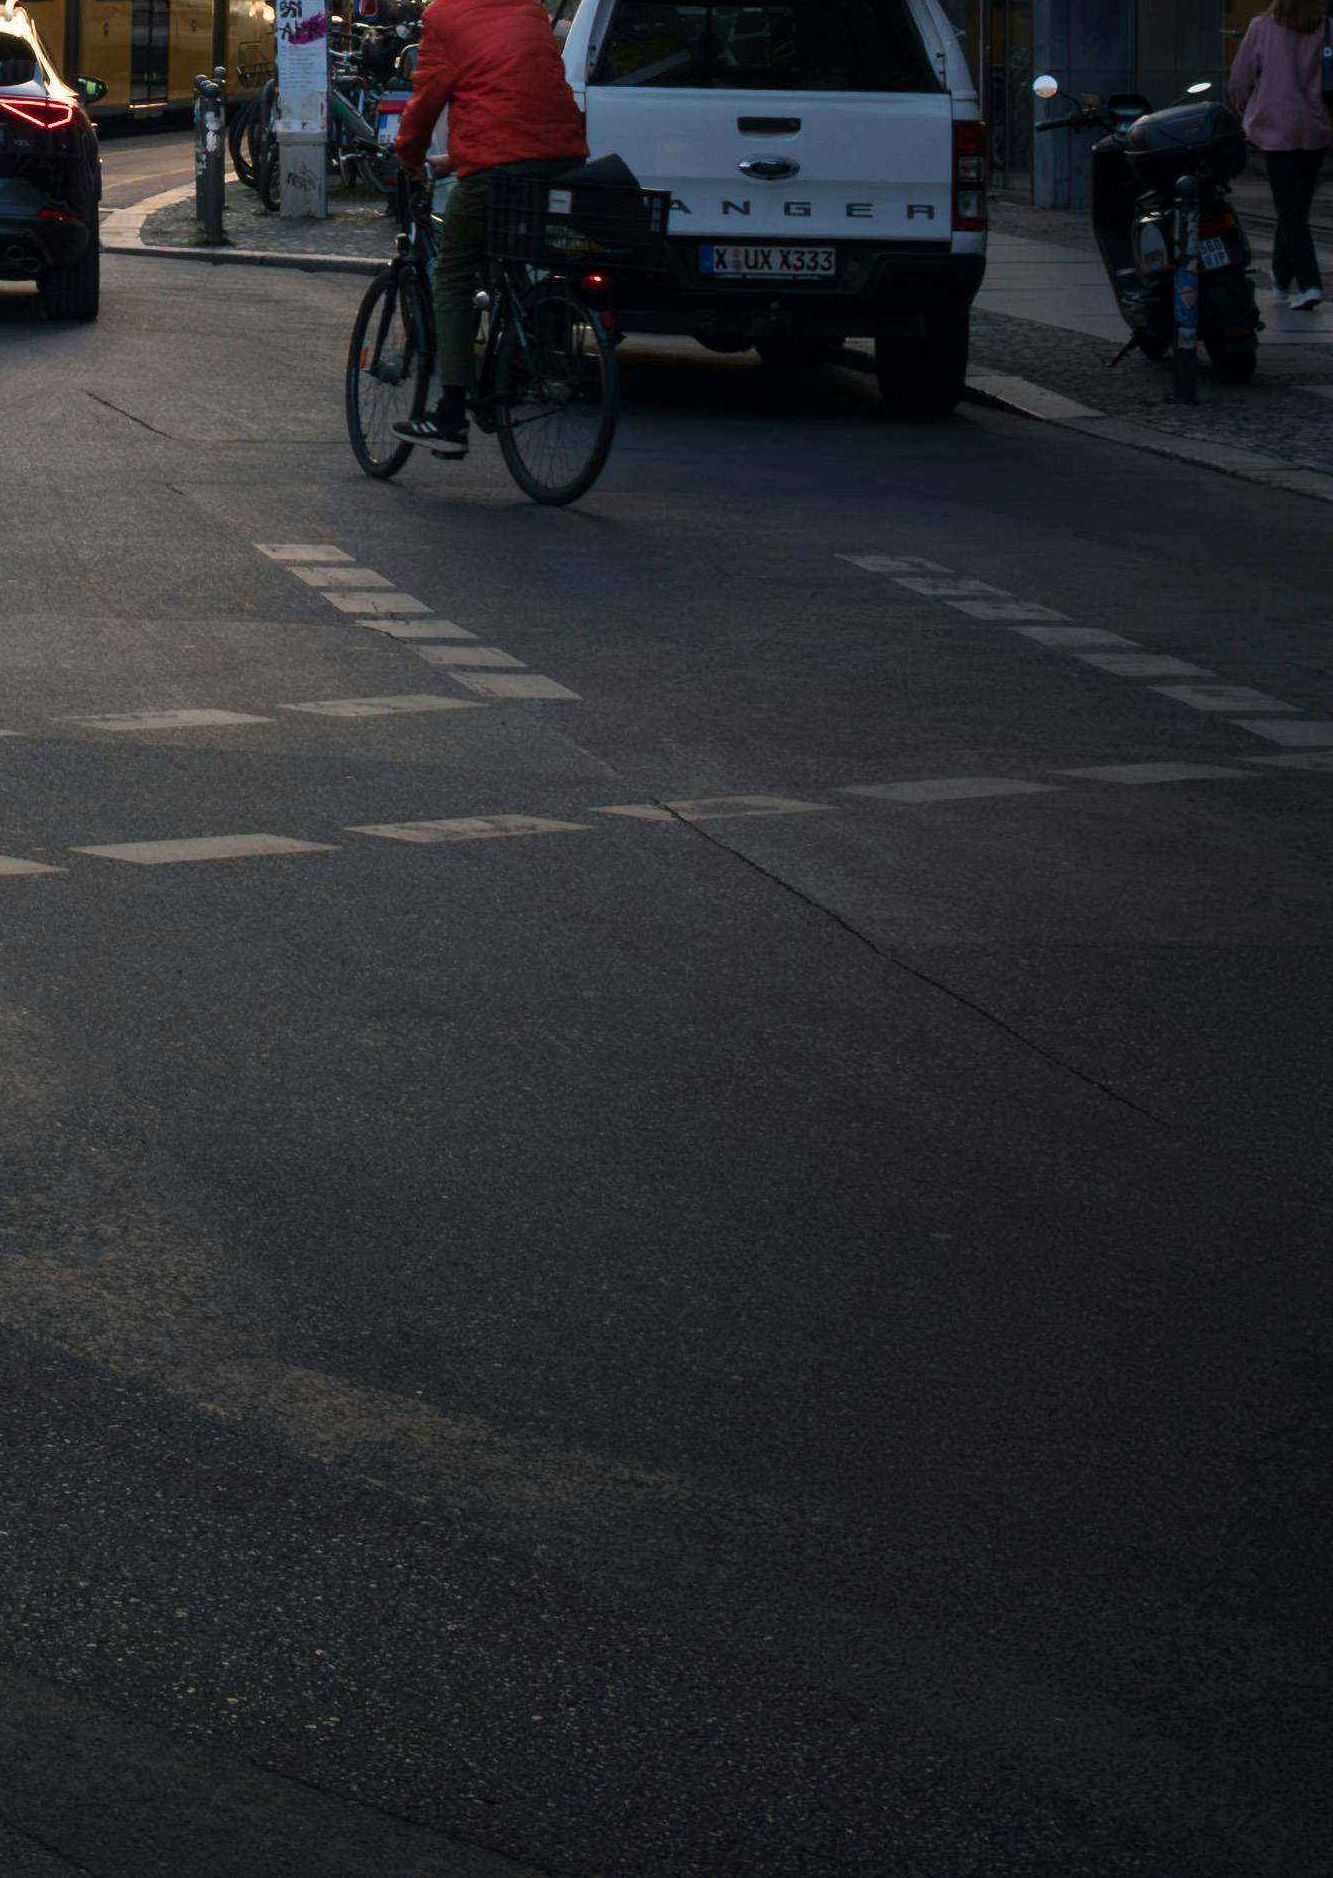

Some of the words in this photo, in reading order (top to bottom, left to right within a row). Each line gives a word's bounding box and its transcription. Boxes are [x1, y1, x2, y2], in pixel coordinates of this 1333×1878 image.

[715, 248, 728, 269] X
[744, 250, 772, 271] UX
[779, 251, 833, 272] X333
